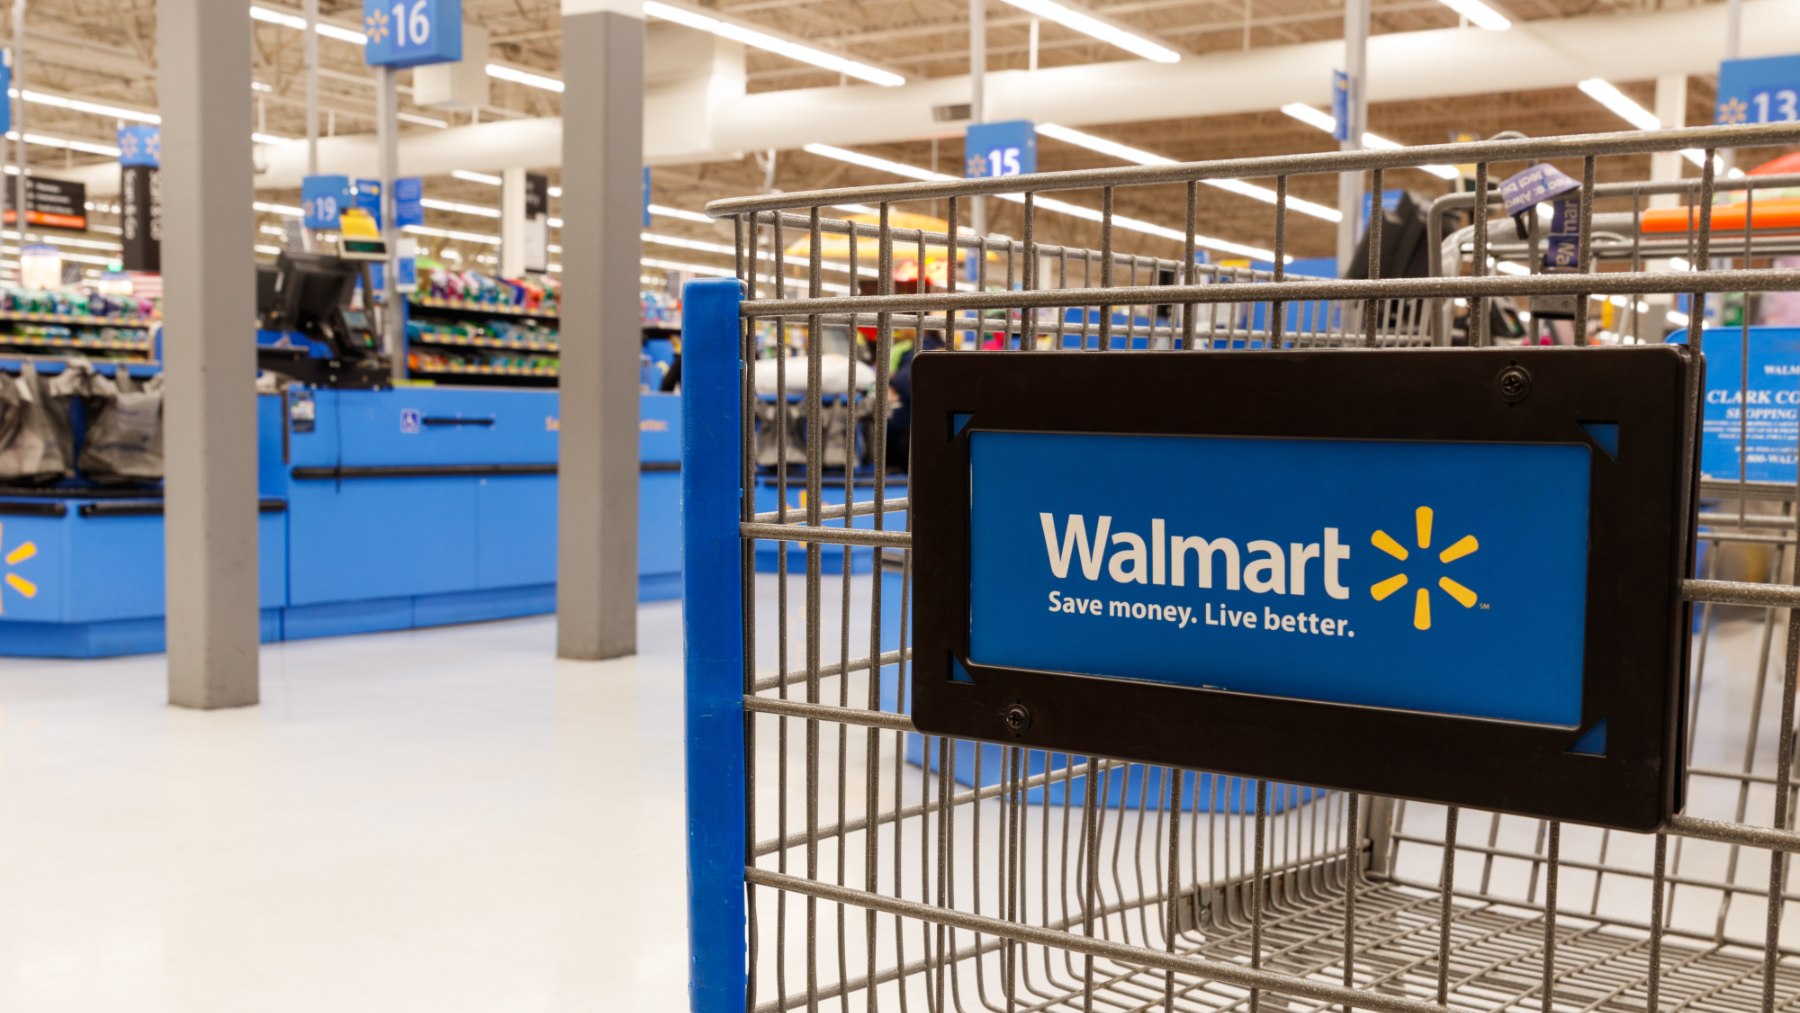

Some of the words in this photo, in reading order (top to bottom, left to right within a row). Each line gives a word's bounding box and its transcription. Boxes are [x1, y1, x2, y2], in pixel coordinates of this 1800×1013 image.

[391, 0, 430, 47] 16
[1752, 89, 1798, 124] 13
[988, 147, 1021, 177] 15
[316, 196, 337, 221] 19
[1707, 390, 1771, 404] CLARK
[1039, 512, 1350, 599] Walmart
[1048, 590, 1103, 616] Save
[1108, 596, 1198, 628] money.
[1204, 603, 1258, 630] Live
[1264, 607, 1355, 638] better.
